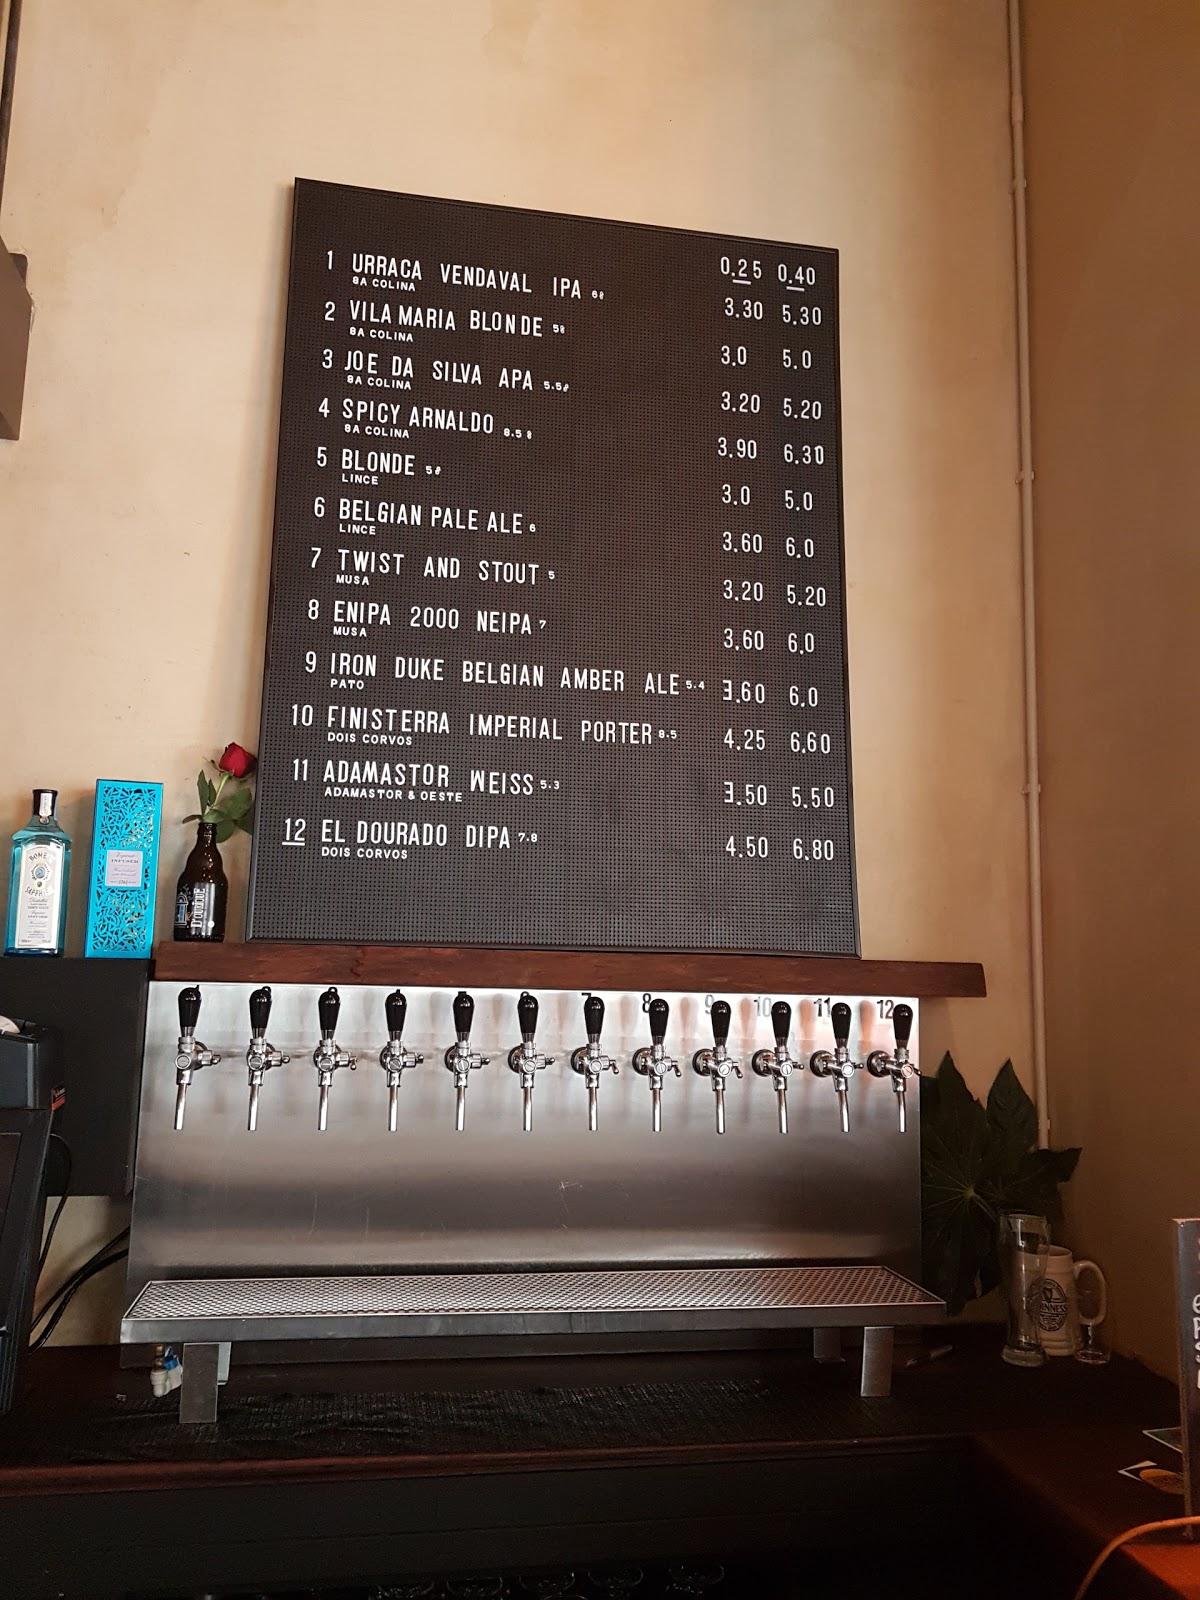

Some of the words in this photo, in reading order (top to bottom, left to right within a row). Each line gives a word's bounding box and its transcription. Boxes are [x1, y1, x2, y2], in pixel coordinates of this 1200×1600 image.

[327, 250, 333, 270] 1
[352, 253, 422, 281] URRACA
[440, 263, 532, 293] VENDAVAL
[553, 276, 581, 300] IPA
[720, 256, 762, 279] 0.25
[778, 263, 816, 285] 0.40
[372, 278, 416, 292] COLINA
[324, 301, 336, 322] 2
[349, 299, 392, 324] VILA
[398, 304, 456, 331] MARIA
[469, 309, 543, 337] BLONDE
[724, 297, 763, 320] 3.30
[782, 304, 822, 326] 5.30
[369, 329, 414, 342] COLINA
[322, 348, 333, 369] 3
[344, 350, 379, 375] JOE
[391, 355, 414, 378] DA
[432, 360, 482, 385] SILVA
[498, 367, 533, 391] APA
[721, 345, 747, 367] 3.0
[782, 349, 812, 370] 5.0
[367, 376, 412, 390] COLINA
[318, 397, 330, 418] 4
[342, 398, 401, 425] SPICY
[408, 406, 494, 434] ARNALDO
[721, 391, 761, 414] 3.20
[783, 397, 822, 420] 5.20
[364, 425, 410, 439] COLINA
[316, 446, 327, 467] 5
[341, 448, 416, 476] BLONDE
[717, 436, 757, 459] 3.90
[783, 443, 824, 465] 6.30
[341, 473, 379, 485] LINCE
[721, 483, 751, 506] 3.0
[784, 489, 813, 511] 5.0
[314, 496, 326, 518] 6
[339, 498, 422, 526] BELGIAN
[431, 506, 479, 531] PALE
[486, 511, 523, 535] ALE
[529, 523, 536, 533] 6
[339, 523, 376, 536] LINCE
[722, 531, 763, 554] 3.60
[785, 537, 814, 559] 6.0
[311, 547, 322, 569] 7
[337, 548, 405, 575] TWIST
[423, 556, 460, 579] AND
[478, 559, 540, 585] STOUT
[548, 570, 556, 580] 5
[335, 574, 370, 586] MUSA
[723, 579, 763, 602] 3.20
[787, 584, 826, 607] 5.20
[307, 598, 320, 620] 8
[333, 600, 391, 626] ENIPA
[410, 605, 459, 630] 2000
[476, 610, 532, 635] NEIPA
[539, 619, 547, 630] 7
[333, 625, 367, 637] MUSA
[723, 627, 764, 651] 3.60
[788, 632, 815, 655] 6.0
[305, 650, 317, 674] 9
[330, 652, 377, 677] IRON
[394, 656, 445, 681] DUKE
[462, 660, 544, 688] BELGIAN
[560, 666, 624, 692] AMBER
[644, 672, 680, 696] ALE
[685, 680, 705, 690] 5.4
[330, 678, 365, 690] PATO
[789, 685, 818, 708] 6.0
[291, 703, 314, 727] 10
[327, 705, 450, 734] FINISTERRA
[469, 713, 563, 740] IMPERIAL
[581, 719, 652, 745] PORTER
[658, 729, 678, 740] 8.5
[327, 731, 356, 743] DOIS
[362, 733, 413, 746] CORVOS
[723, 728, 766, 751] 4.25
[790, 731, 831, 754] 6.60
[293, 758, 308, 782] 11
[323, 759, 449, 788] ADAMASTOR
[470, 769, 534, 796] WEISS
[540, 779, 560, 790] 5.3
[324, 786, 403, 800] ADAMASTOR
[407, 790, 416, 801] &
[420, 790, 463, 803] OESTE
[791, 786, 834, 809] 5.50
[284, 817, 307, 842] 12
[321, 819, 346, 843] EL
[356, 820, 448, 847] DOURADO
[465, 824, 511, 849] DIPA
[518, 832, 538, 843] 7.8
[321, 846, 351, 858] DOIS
[356, 847, 408, 860] CORVOS
[725, 835, 769, 858] 4.50
[792, 838, 834, 861] 6.80
[642, 992, 652, 1014] 8
[753, 997, 772, 1018] 10
[813, 997, 831, 1018] 11
[876, 999, 895, 1020] 12
